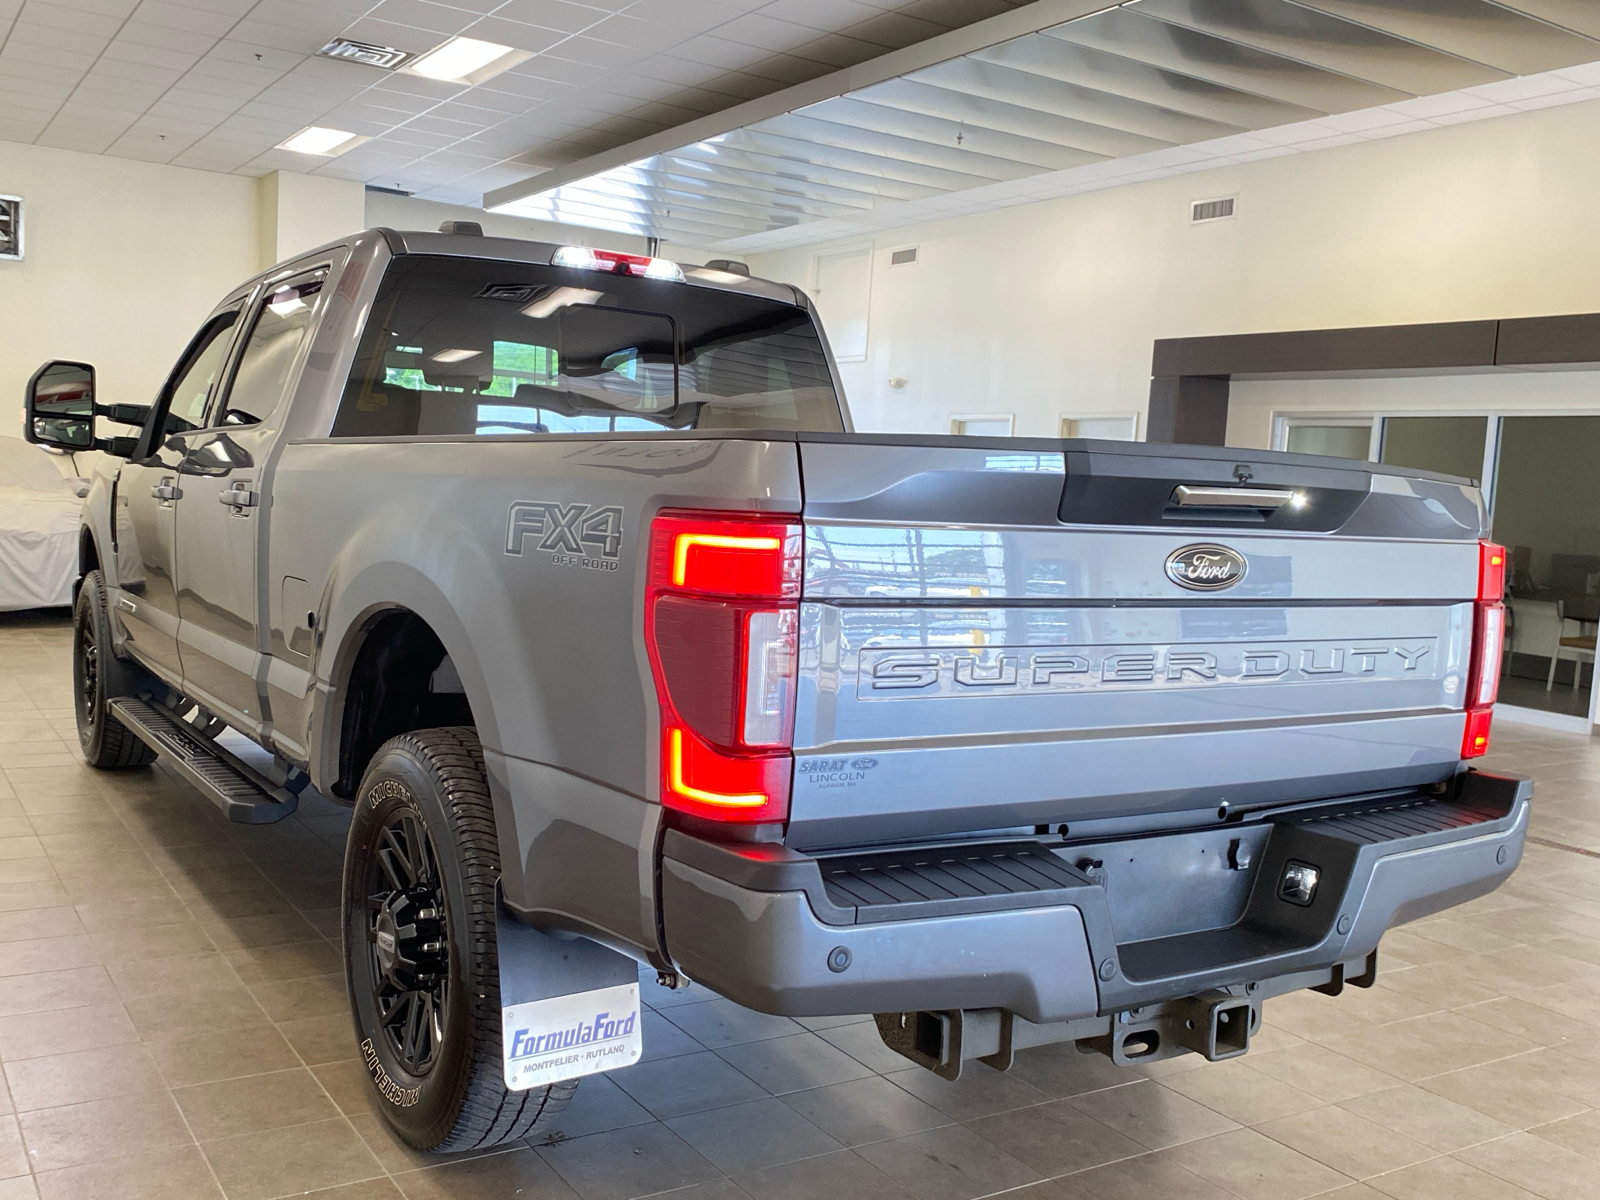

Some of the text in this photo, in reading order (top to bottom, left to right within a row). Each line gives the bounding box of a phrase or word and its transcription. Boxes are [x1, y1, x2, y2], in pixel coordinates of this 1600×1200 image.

[504, 500, 624, 560] FX4
[552, 554, 619, 572] OFF ROAD
[1188, 553, 1231, 579] Ford
[872, 645, 1430, 690] SUPER DUTY
[798, 758, 849, 774] SARAT
[809, 771, 865, 783] LINCOLN
[508, 1011, 637, 1060] FormulaFord
[361, 1038, 421, 1107] MICHELIN
[523, 1044, 625, 1074] MONTPELIER RUTLAND
